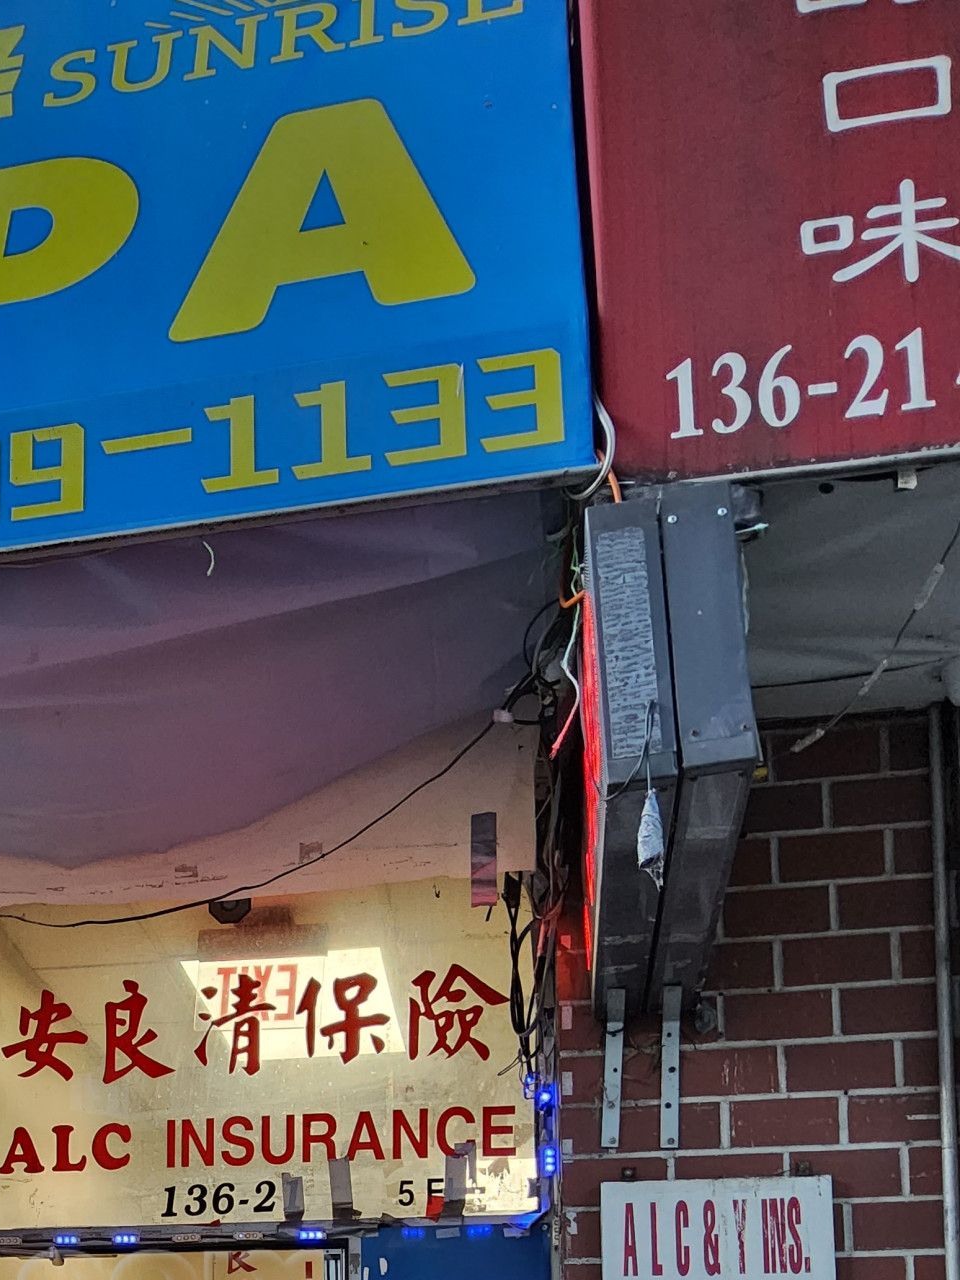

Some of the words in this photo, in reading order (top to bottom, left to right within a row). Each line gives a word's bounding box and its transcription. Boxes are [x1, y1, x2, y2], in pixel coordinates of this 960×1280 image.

[666, 327, 936, 439] 136-21
[1, 963, 510, 1084] 安良清保險
[166, 1105, 518, 1169] INSURANCE
[398, 1180, 414, 1206] 5
[703, 1199, 721, 1276] &
[733, 1199, 747, 1275] Y
[761, 1196, 811, 1275] INS.
